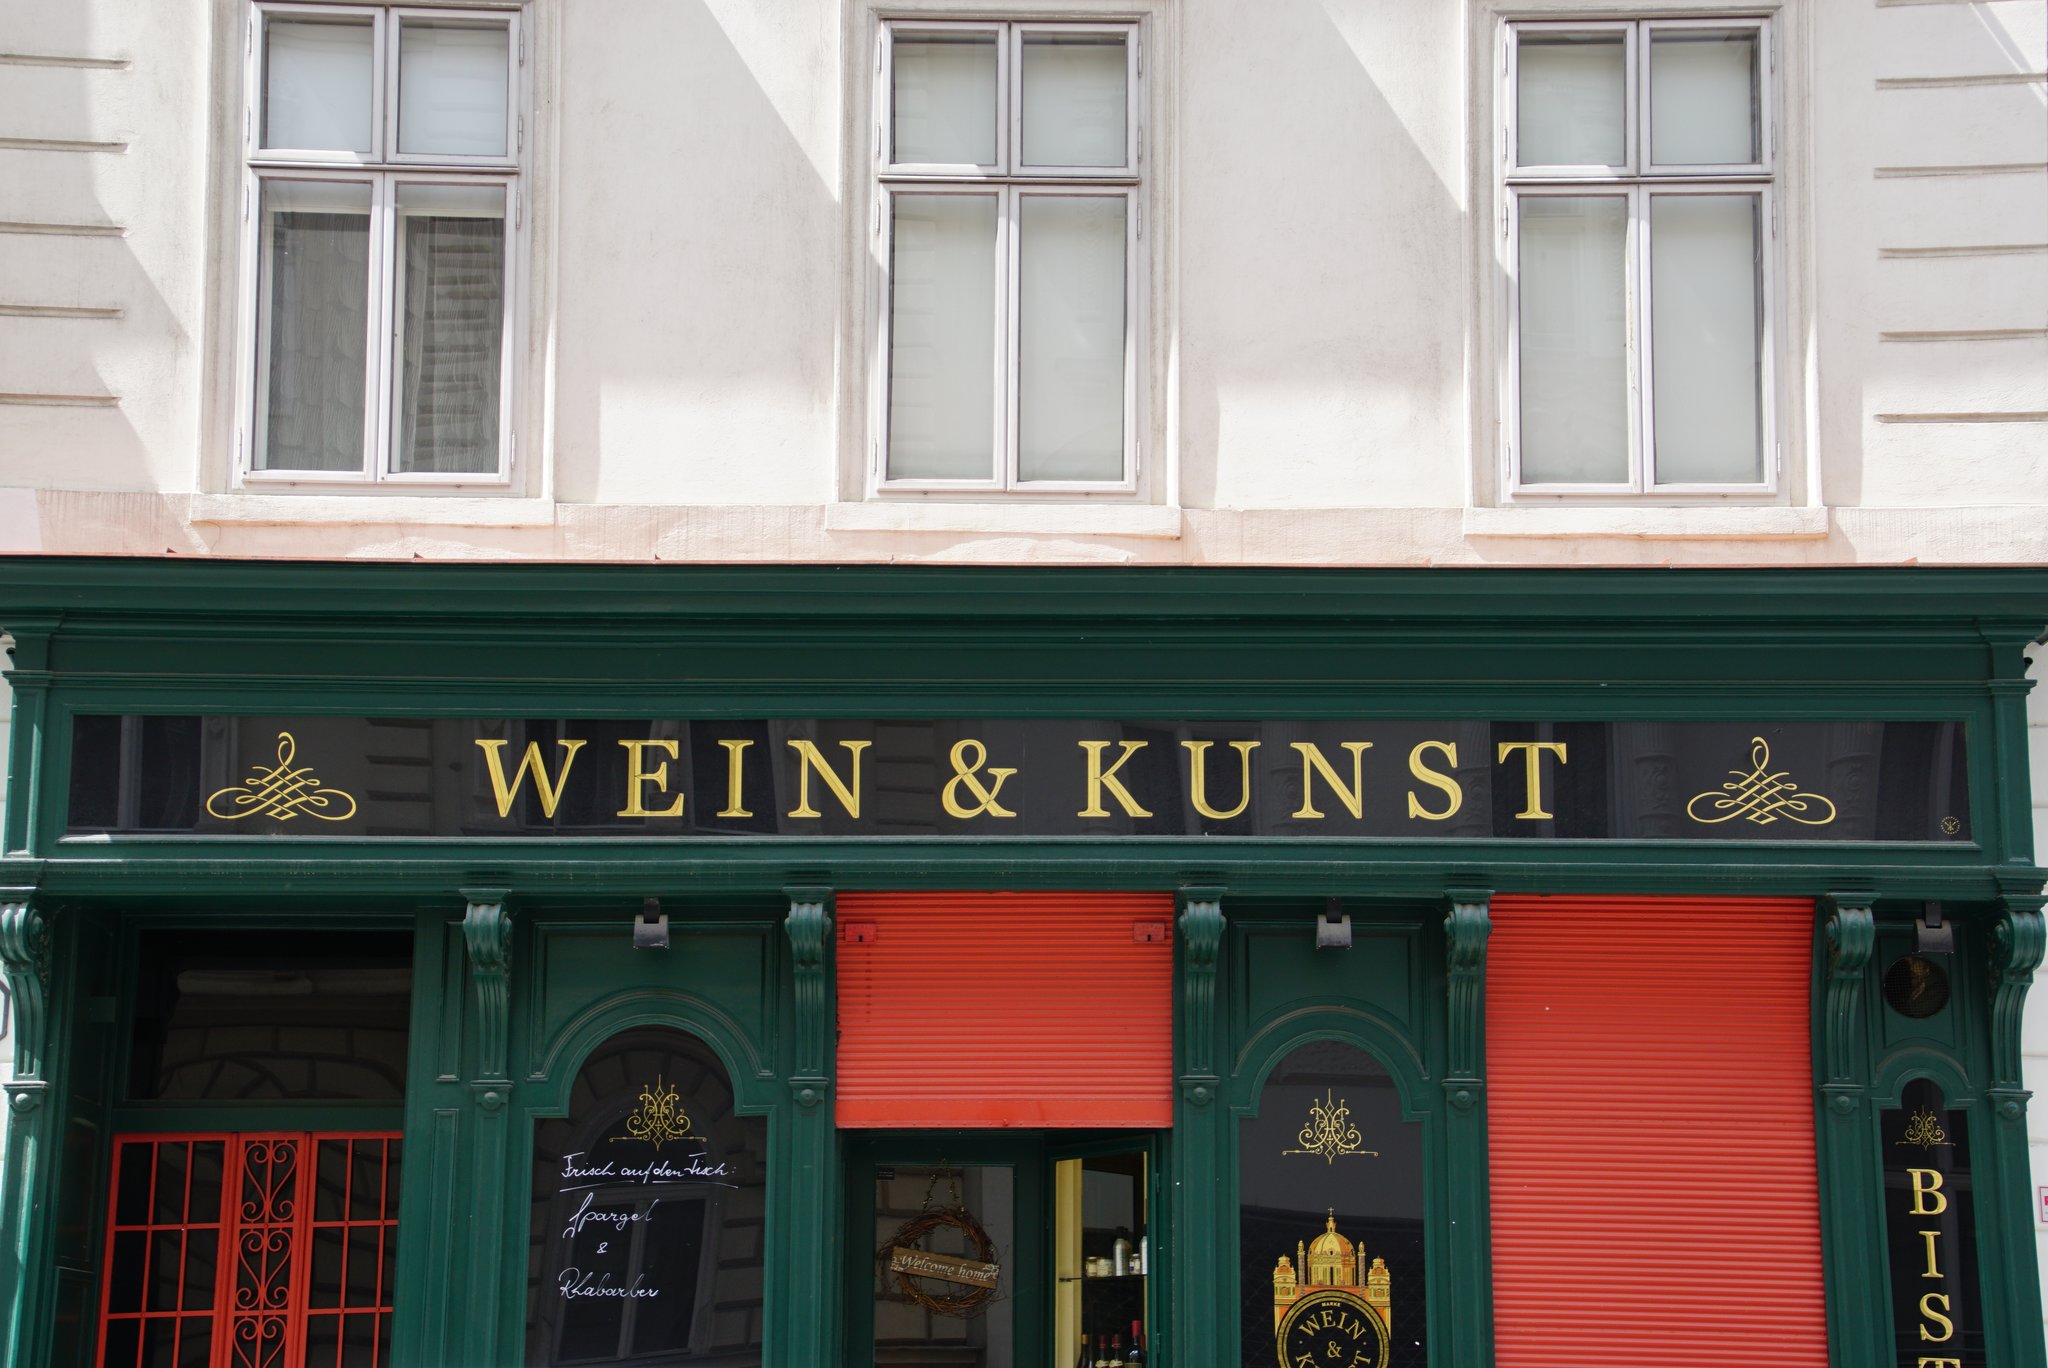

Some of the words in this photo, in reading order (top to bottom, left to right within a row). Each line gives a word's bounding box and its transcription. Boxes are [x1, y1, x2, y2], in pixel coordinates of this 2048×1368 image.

[474, 738, 872, 820] WEIN
[941, 738, 1018, 819] &
[1077, 740, 1569, 821] KUNST
[561, 1152, 616, 1178] Frisch
[562, 1192, 660, 1239] Spargel
[597, 1242, 607, 1254] &
[558, 1267, 660, 1299] Rhabarber
[900, 1255, 954, 1276] Welcome
[957, 1263, 991, 1282] home
[1905, 1168, 1961, 1368] BIS
[1298, 1309, 1367, 1340] WEIN
[1326, 1340, 1342, 1358] &
